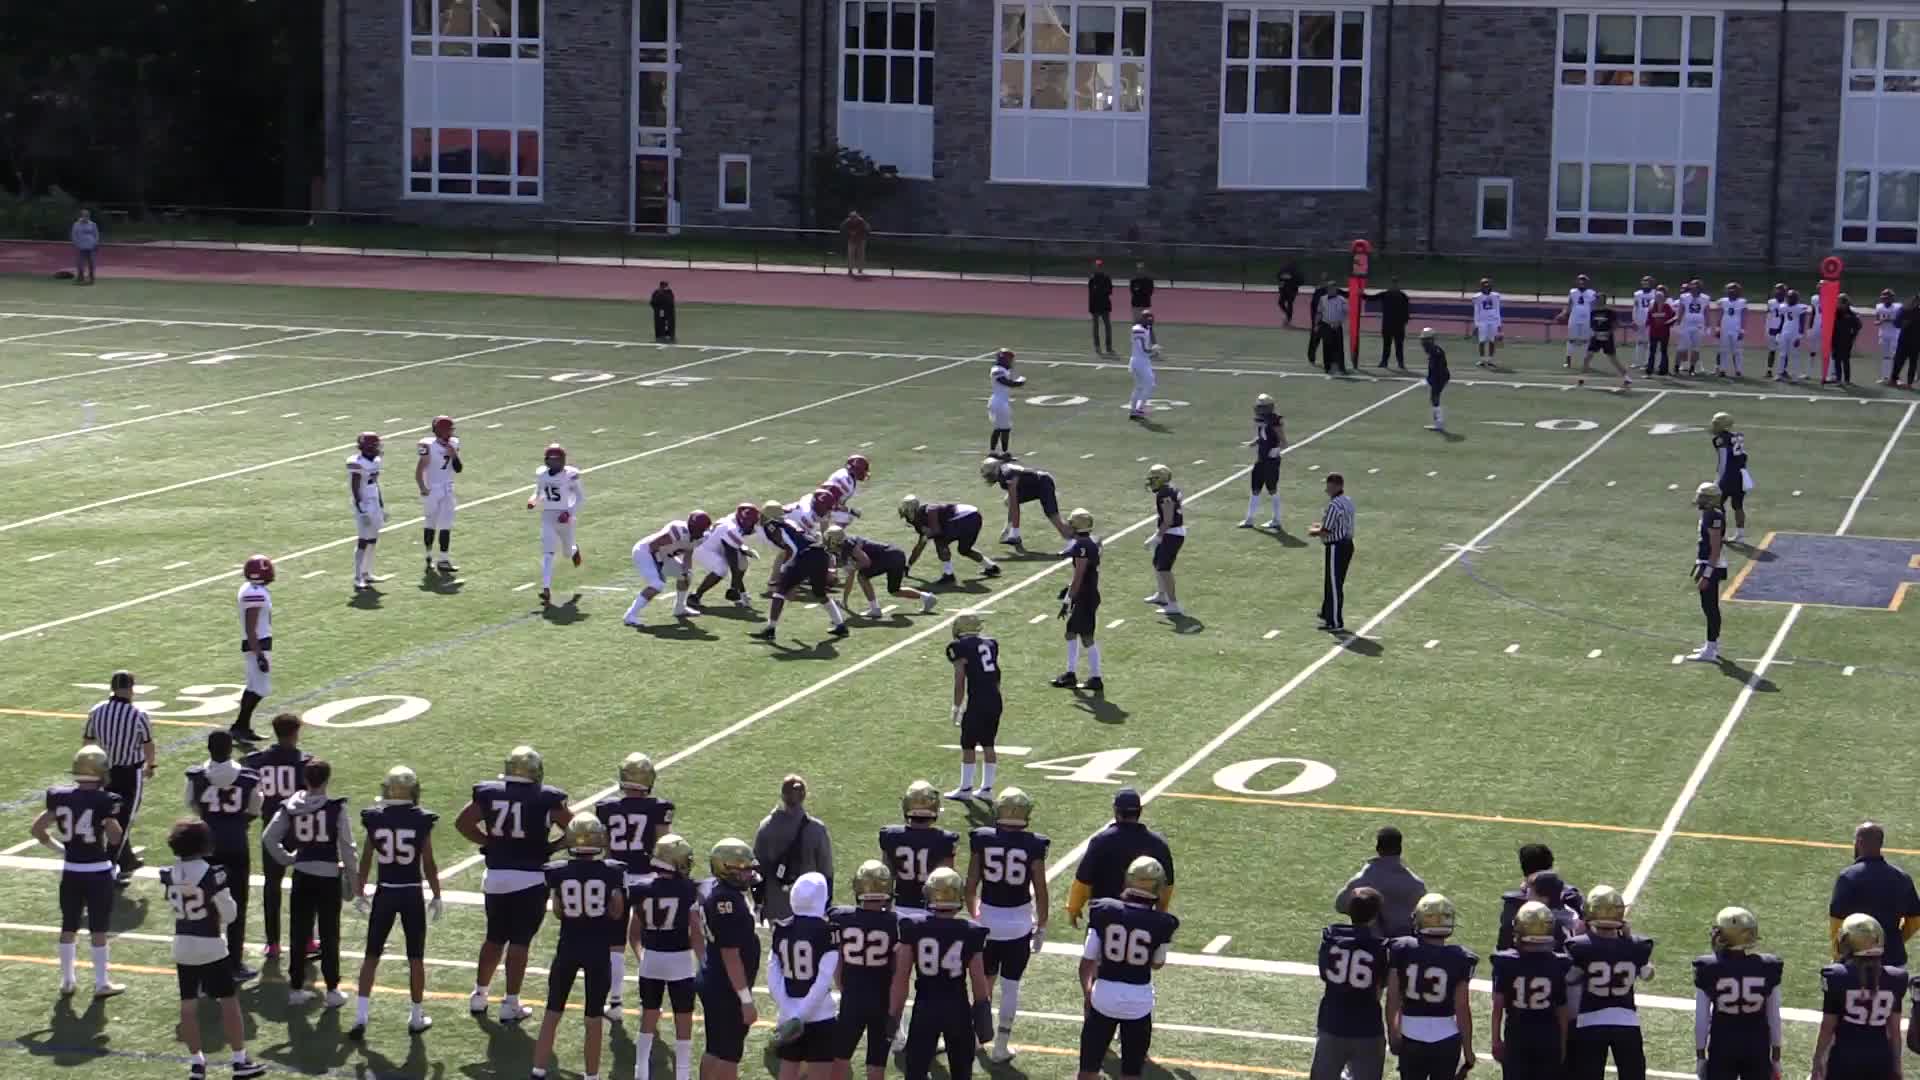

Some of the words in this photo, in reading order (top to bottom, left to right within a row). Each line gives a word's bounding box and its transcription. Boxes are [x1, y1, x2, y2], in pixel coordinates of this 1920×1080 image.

[543, 485, 562, 502] 15
[977, 642, 997, 673] 2
[199, 785, 244, 813] 43
[259, 764, 296, 797] 80
[55, 805, 97, 844] 34
[294, 809, 330, 843] 81
[491, 799, 527, 839] 71
[608, 813, 649, 851] 27
[374, 828, 416, 866] 35
[895, 845, 929, 883] 31
[984, 847, 1028, 886] 56
[642, 896, 681, 931] 17
[778, 938, 814, 981] 18
[841, 926, 890, 968] 22
[917, 936, 964, 978] 84
[1105, 923, 1152, 966] 86
[1325, 945, 1374, 989] 36
[1405, 963, 1449, 1003] 13
[1587, 960, 1637, 998] 23
[1512, 976, 1552, 1010] 12
[1715, 975, 1767, 1015] 25
[1844, 988, 1895, 1027] 58
